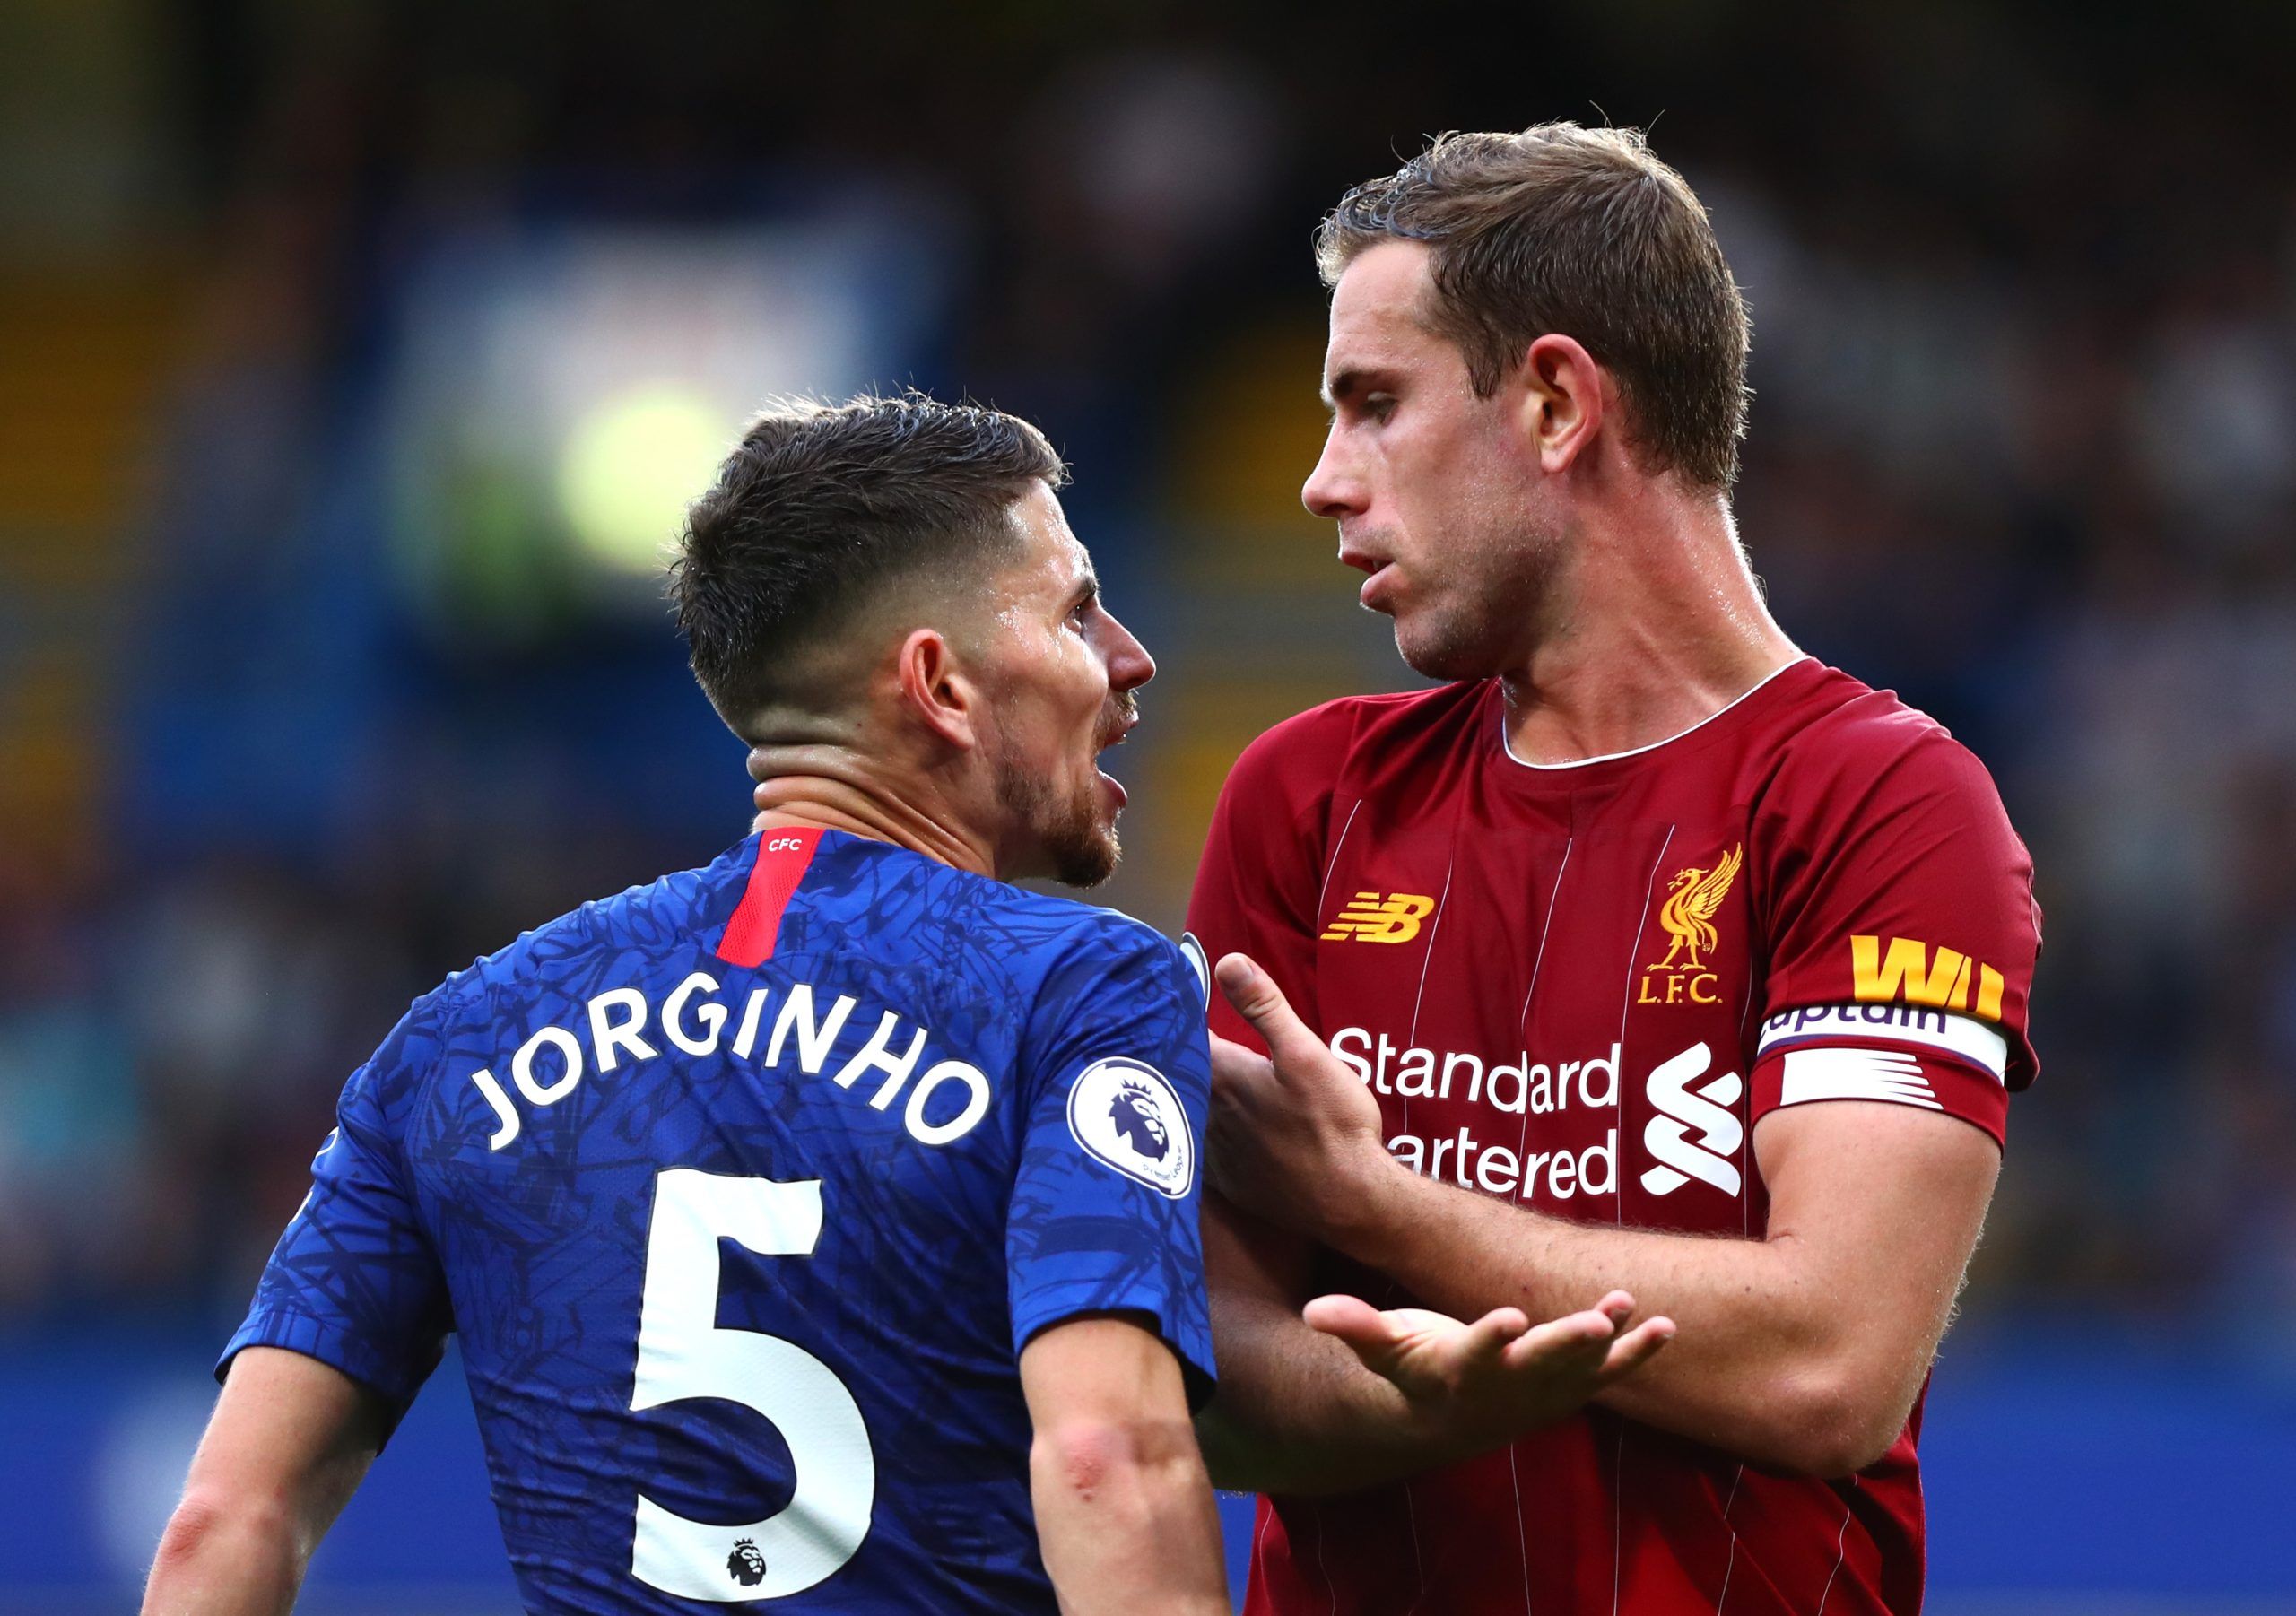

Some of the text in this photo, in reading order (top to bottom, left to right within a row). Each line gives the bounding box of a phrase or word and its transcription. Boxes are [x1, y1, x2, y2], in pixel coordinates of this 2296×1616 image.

[768, 838, 802, 852] CFC
[1637, 973, 1723, 1003] L.F.C.
[1760, 1003, 1947, 1035] aptain
[471, 972, 991, 1152] JORGINHO
[1329, 1027, 1621, 1115] Standard
[1387, 1127, 1617, 1199] artered
[630, 1168, 875, 1603] 5
